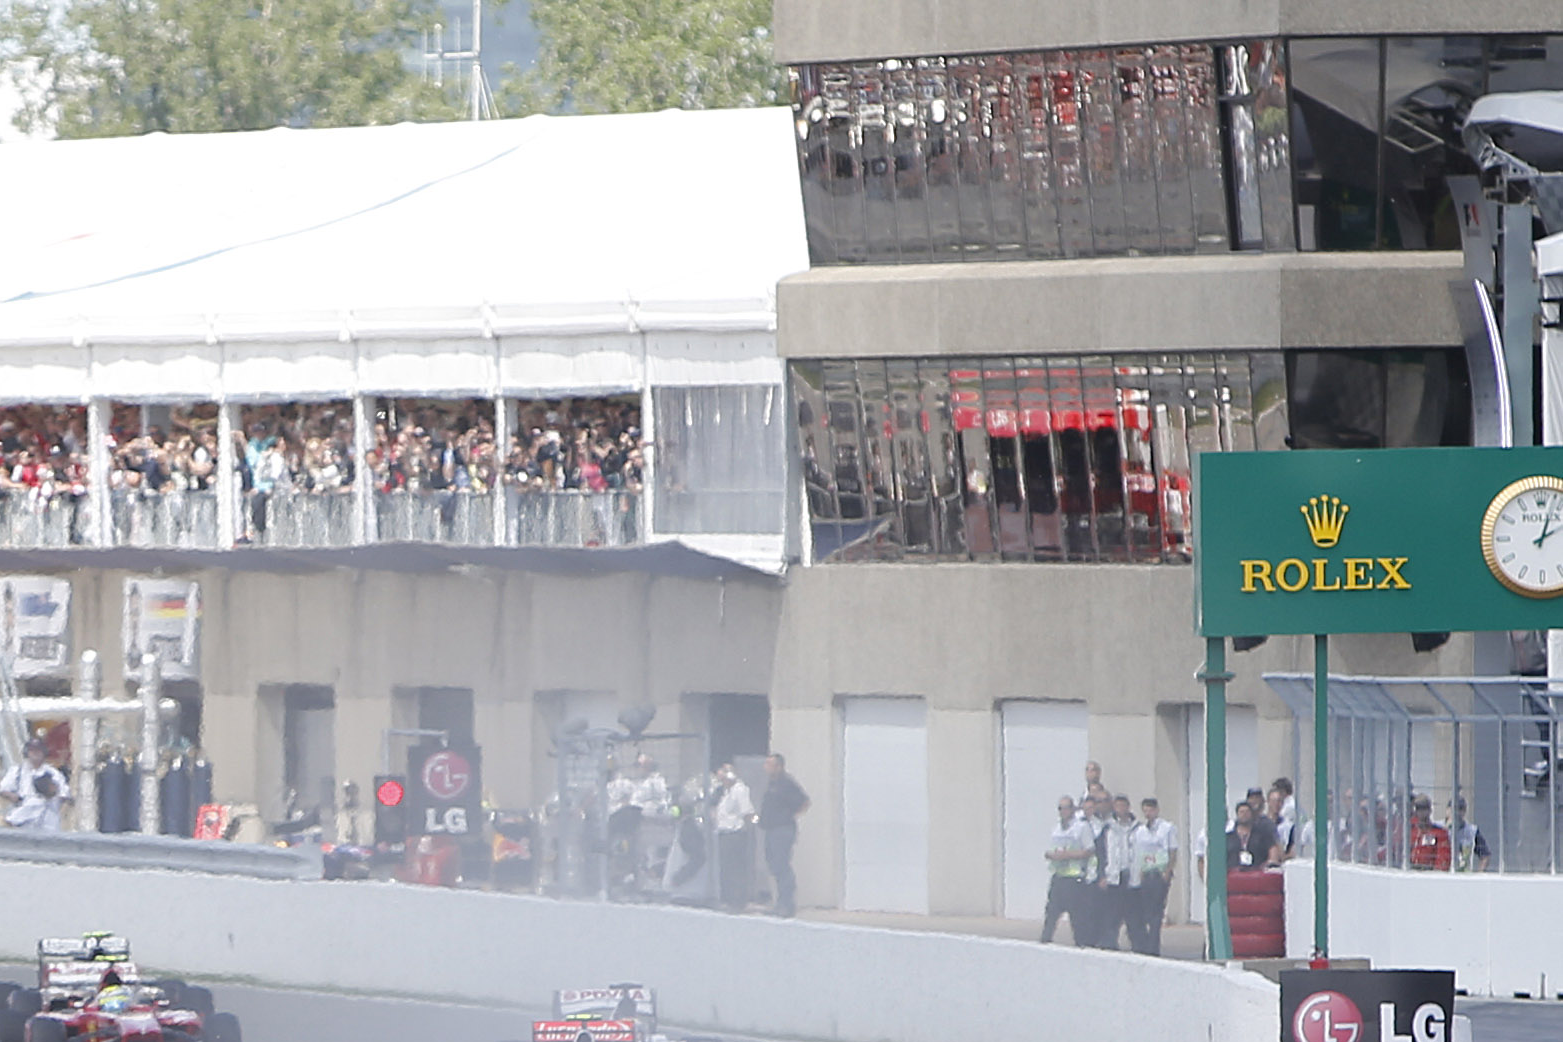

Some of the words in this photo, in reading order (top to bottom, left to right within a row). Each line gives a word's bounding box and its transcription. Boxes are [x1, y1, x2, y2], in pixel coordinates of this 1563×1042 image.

[1239, 557, 1413, 593] ROLEX
[424, 807, 469, 834] LG
[580, 987, 644, 1001] PDVA
